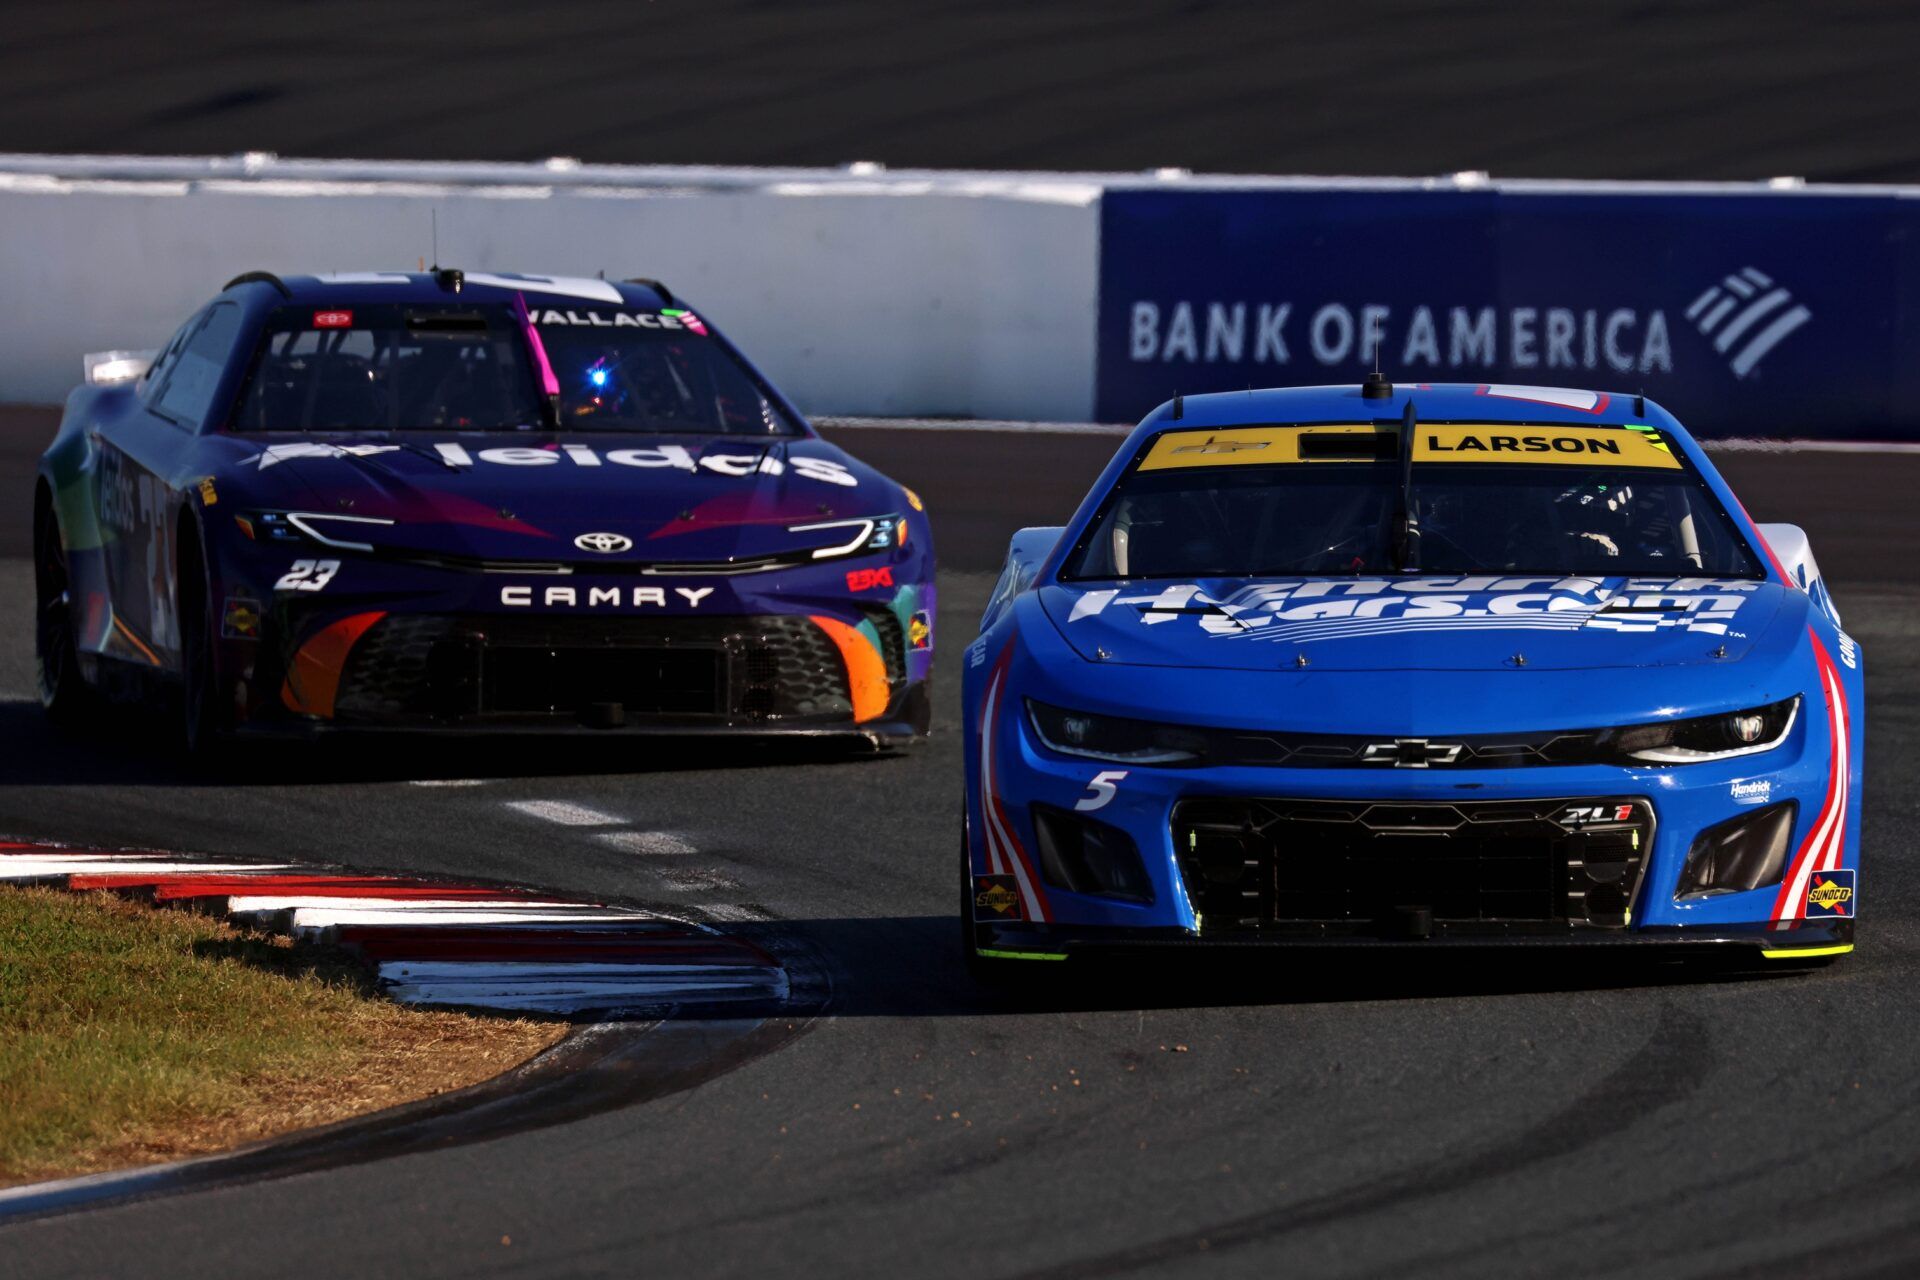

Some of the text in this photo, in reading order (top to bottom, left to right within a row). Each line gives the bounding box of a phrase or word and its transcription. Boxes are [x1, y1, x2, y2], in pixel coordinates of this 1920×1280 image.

[1130, 302, 1673, 373] BANK OF AMERICA
[1428, 436, 1621, 454] LARSON
[273, 559, 341, 591] 23
[501, 586, 714, 607] CAMRY
[1074, 770, 1128, 811] 5
[1560, 804, 1633, 824] ZL1
[1809, 889, 1850, 902] SUNOCO
